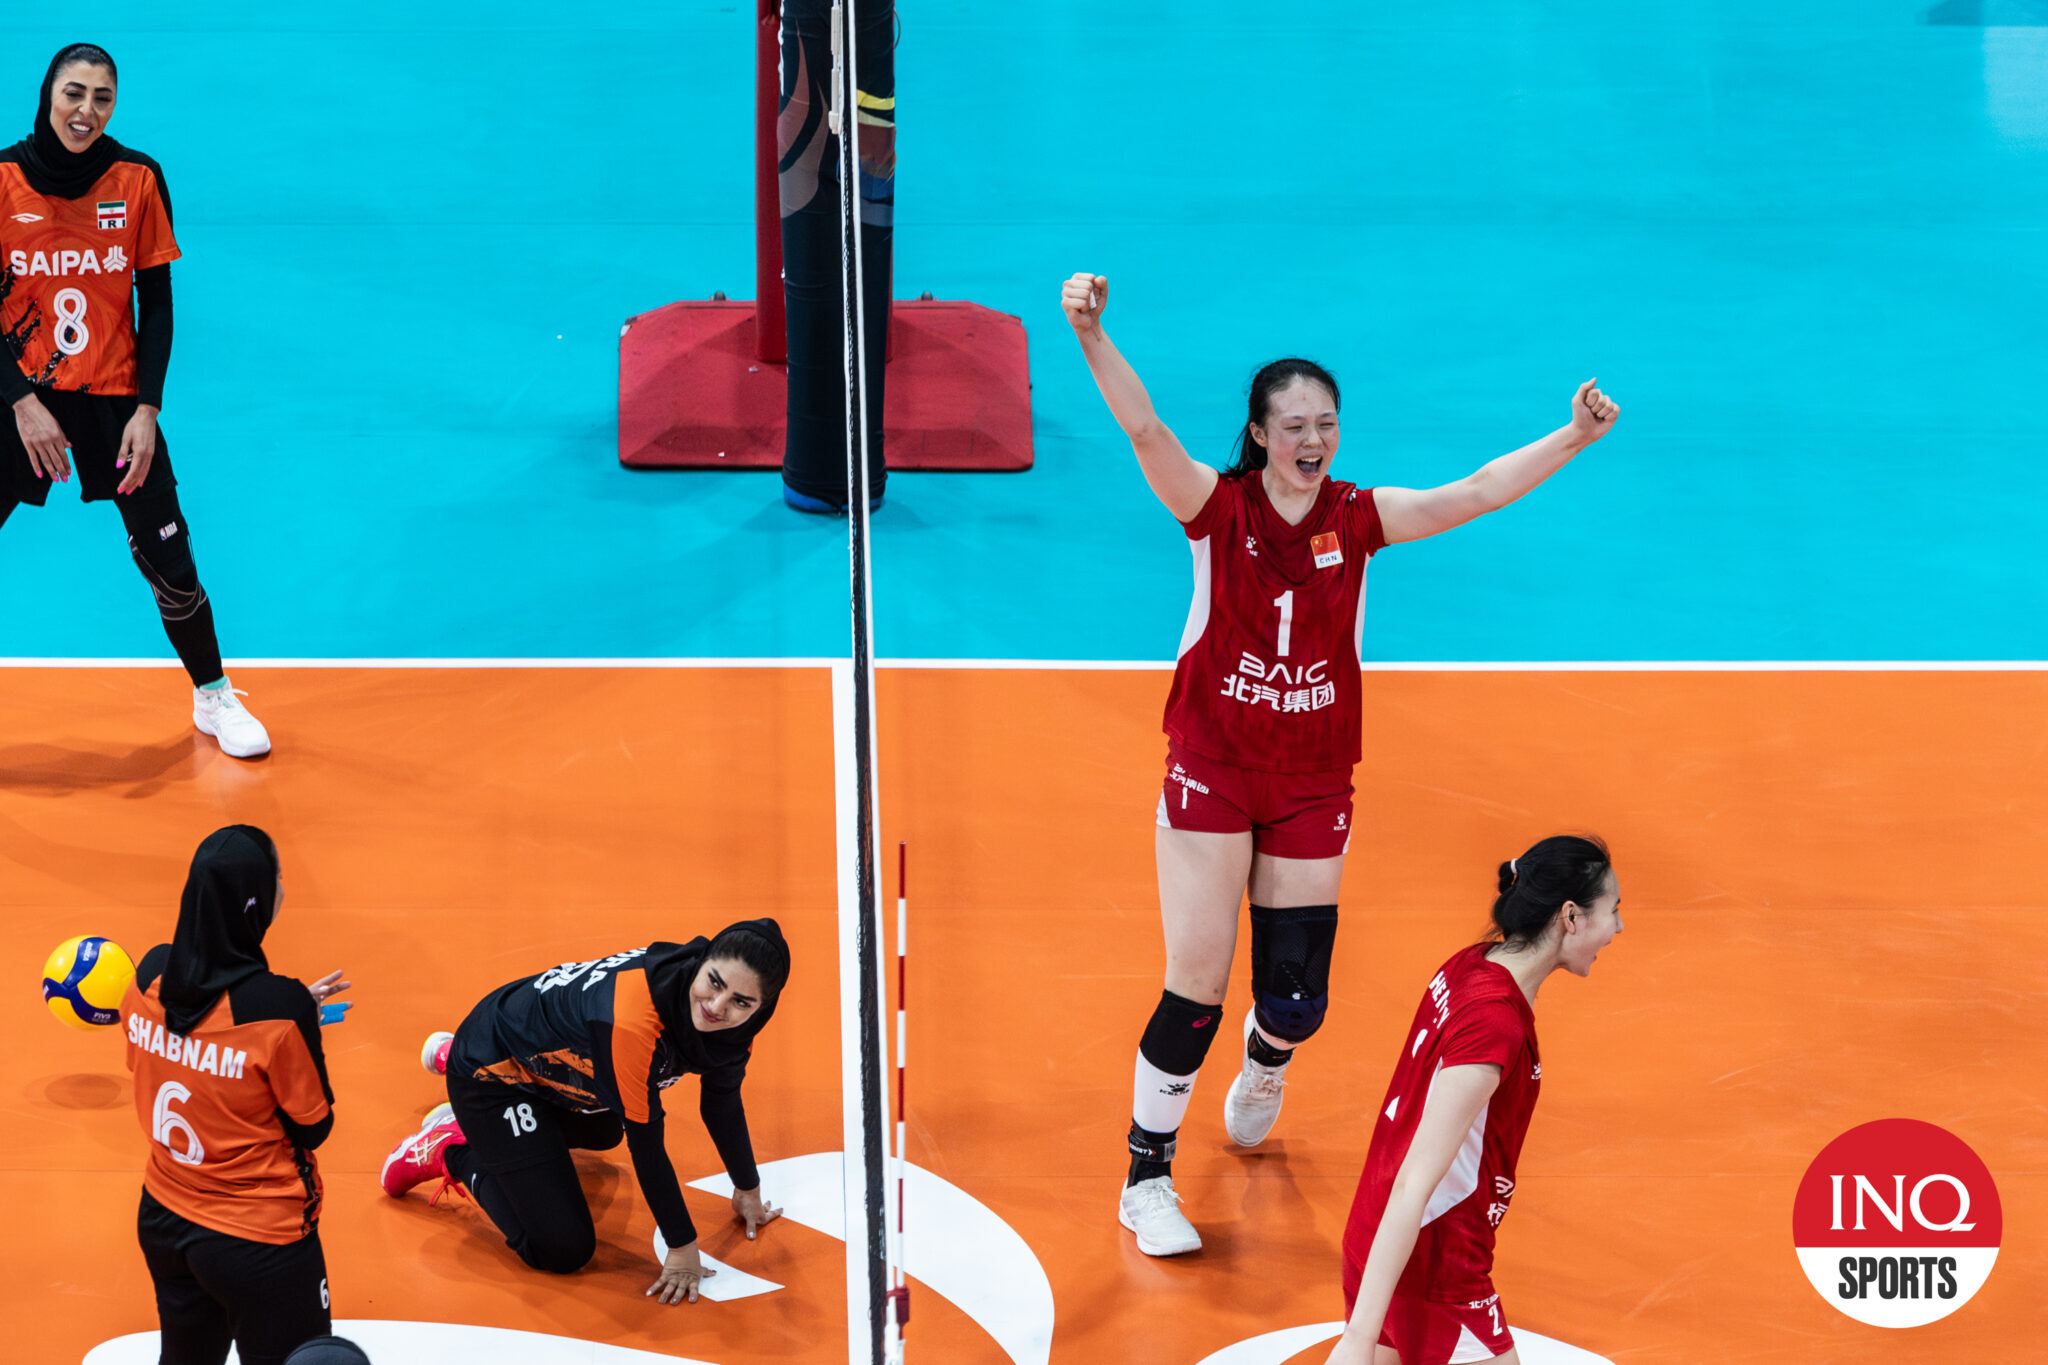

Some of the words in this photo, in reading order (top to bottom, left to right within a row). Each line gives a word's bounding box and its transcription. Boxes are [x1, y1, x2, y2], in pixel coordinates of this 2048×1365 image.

[98, 219, 126, 229] IRI
[10, 249, 102, 276] SAIPA
[53, 287, 89, 355] 8
[1273, 590, 1294, 656] 1
[1239, 651, 1328, 685] BAIC
[1220, 674, 1335, 713] 北汽集团
[128, 1013, 247, 1079] SHABNAM
[153, 1081, 205, 1165] 6
[503, 1103, 537, 1137] 18
[320, 1278, 329, 1309] 6
[1488, 1304, 1503, 1336] 2
